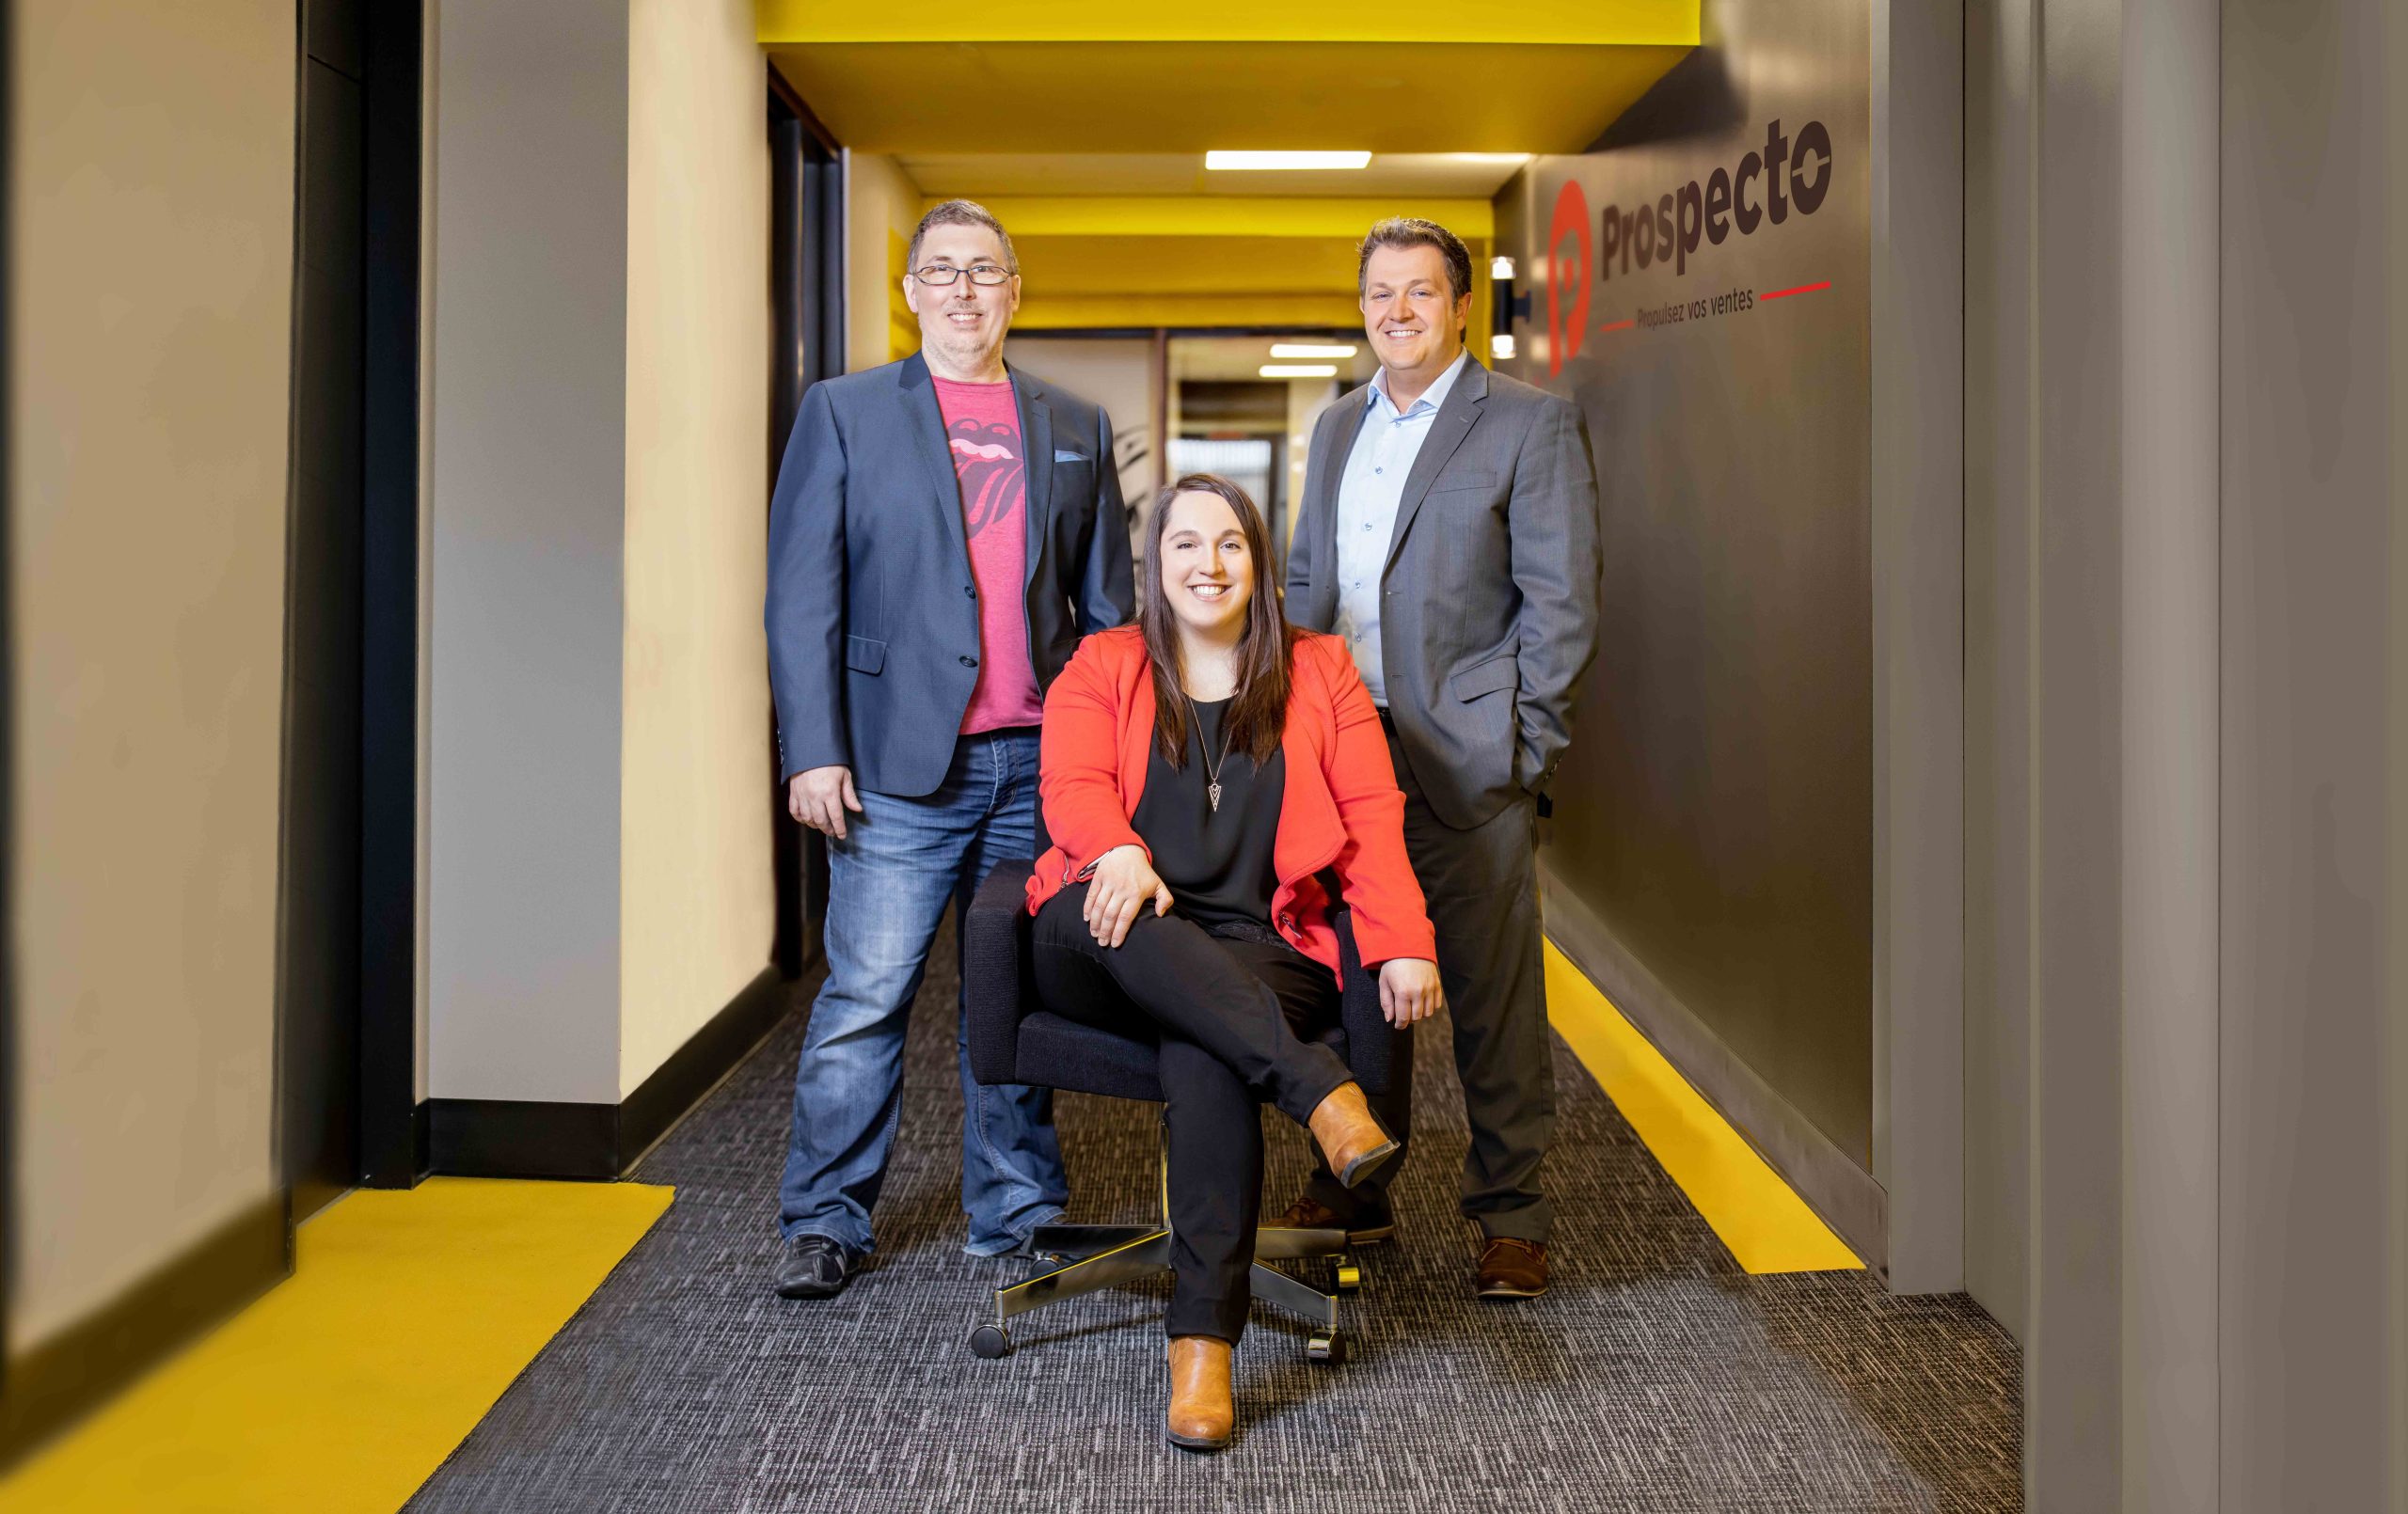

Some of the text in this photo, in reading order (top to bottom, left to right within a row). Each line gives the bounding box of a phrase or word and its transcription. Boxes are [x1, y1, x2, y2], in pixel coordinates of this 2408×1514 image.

[1602, 118, 1832, 282] Prospecto
[1638, 287, 1754, 330] Propulsez vos ventes
